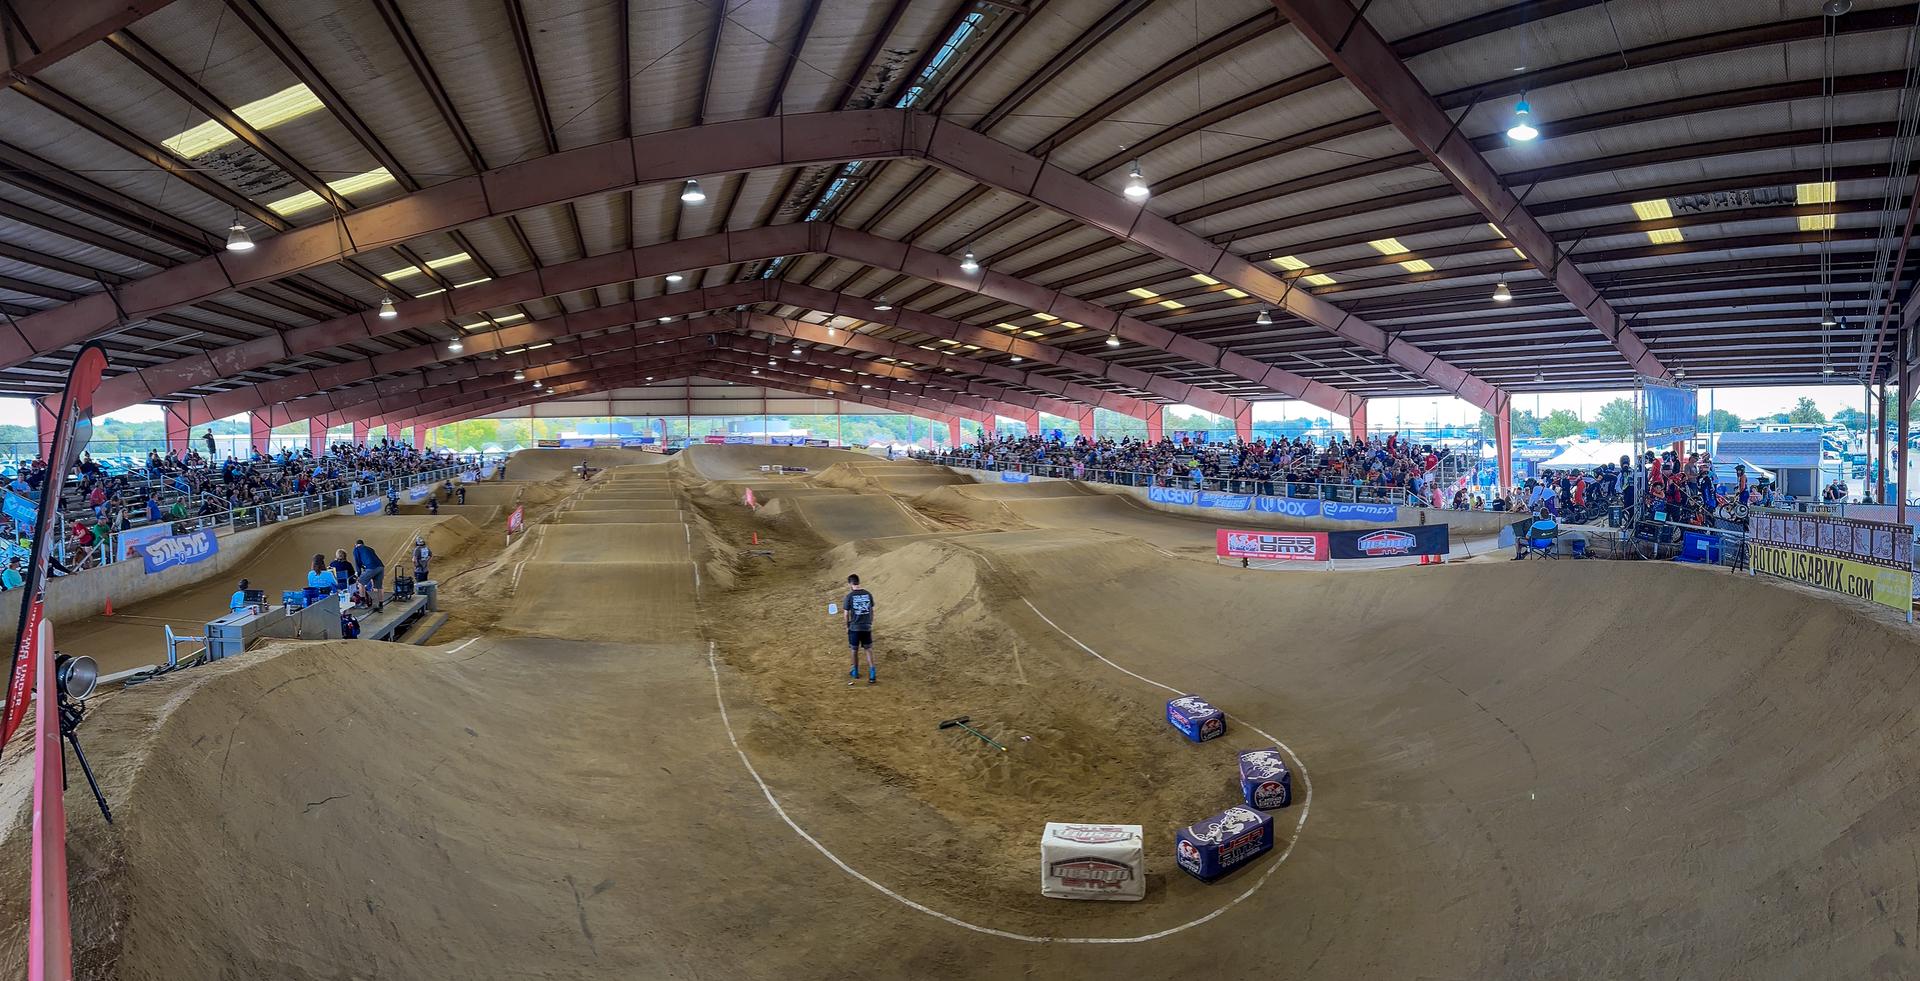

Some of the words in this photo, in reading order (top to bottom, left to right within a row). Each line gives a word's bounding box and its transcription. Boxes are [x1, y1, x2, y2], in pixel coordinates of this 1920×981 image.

[1277, 498, 1307, 516] box
[1339, 504, 1395, 515] promax
[1259, 535, 1315, 545] USA
[146, 532, 210, 565] STACYC
[1259, 544, 1316, 554] BMX
[15, 664, 29, 706] UNDER
